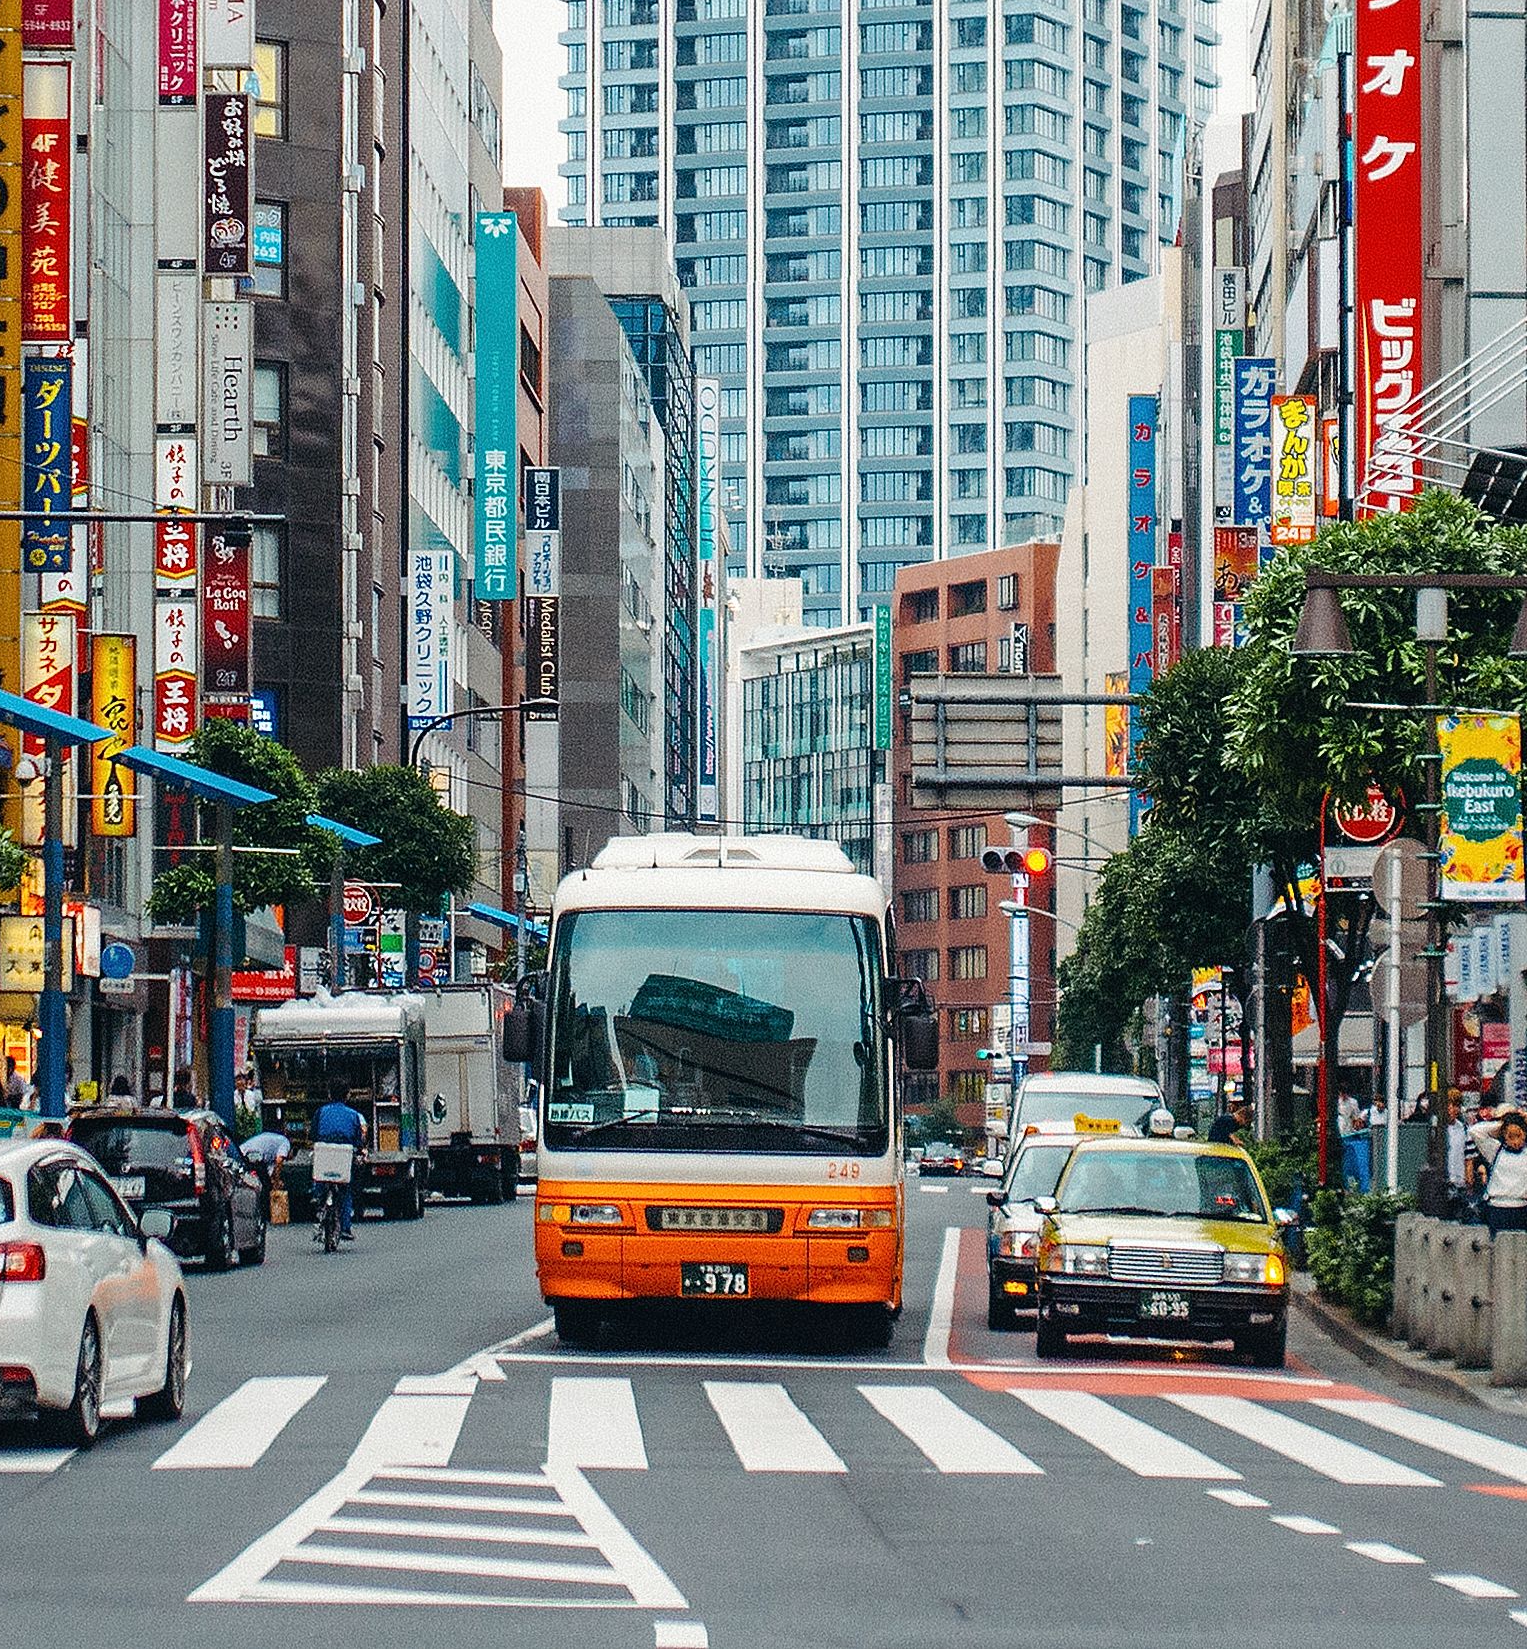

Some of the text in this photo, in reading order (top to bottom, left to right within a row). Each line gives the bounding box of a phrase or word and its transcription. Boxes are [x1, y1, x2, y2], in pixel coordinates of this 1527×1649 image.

[30, 133, 60, 153] 4F
[28, 157, 63, 277] 健美苑
[222, 355, 244, 442] Hearth
[1280, 398, 1310, 480] まんが
[34, 378, 66, 525] ダーツバー
[699, 385, 719, 548] JUNKUDO
[161, 443, 190, 569] 餃子の王将
[484, 449, 508, 592] 東京都民銀行
[161, 607, 190, 731] 餃子の王将
[414, 554, 434, 715] 池袋久野クリニック
[540, 598, 556, 657] Medalist
[540, 661, 556, 696] Club
[1446, 783, 1515, 799] Ikebukuro
[1452, 771, 1494, 784] Welcome
[1463, 799, 1495, 813] East
[828, 1161, 860, 1180] 249
